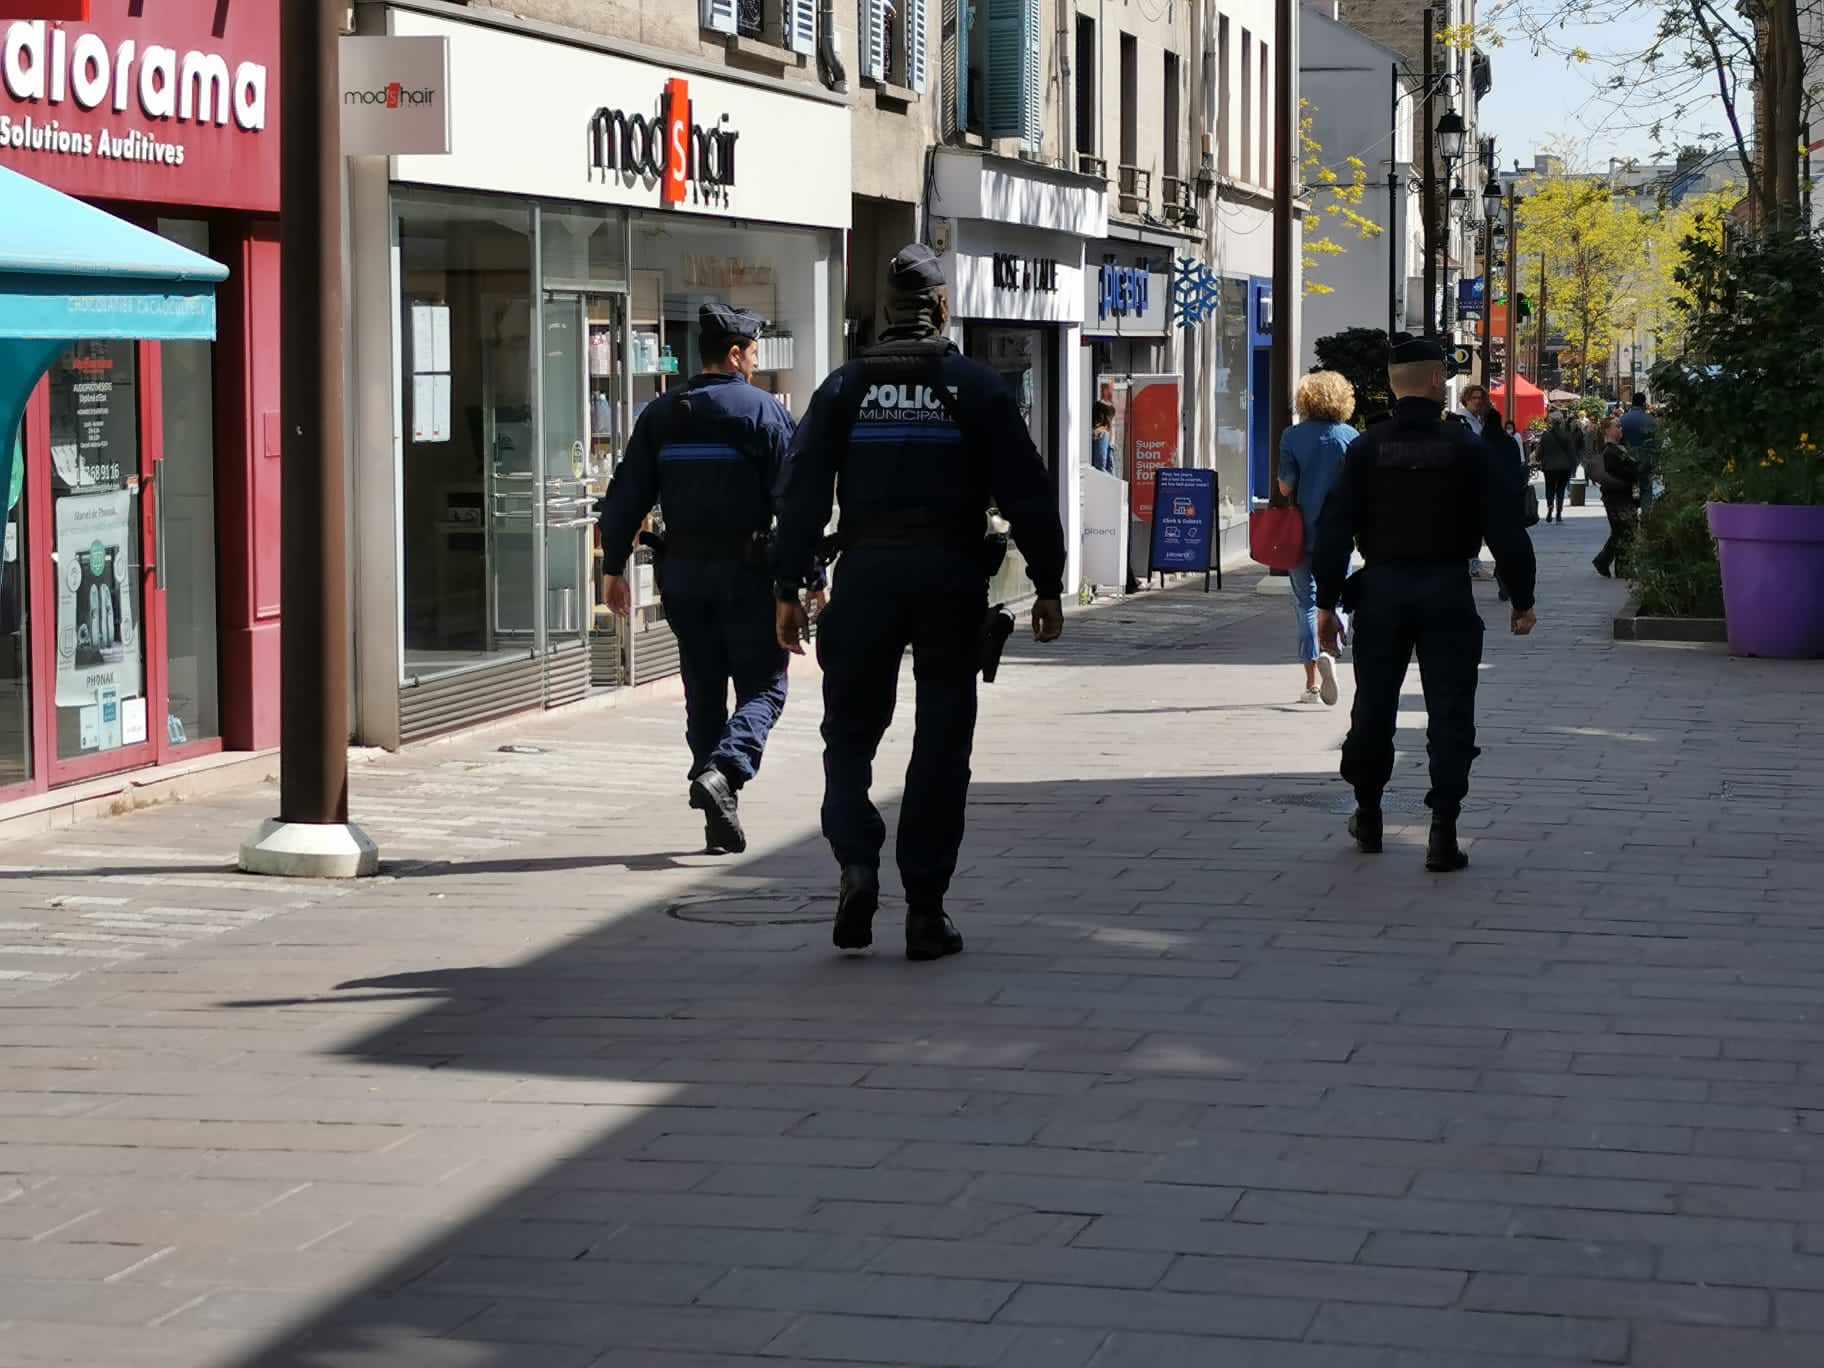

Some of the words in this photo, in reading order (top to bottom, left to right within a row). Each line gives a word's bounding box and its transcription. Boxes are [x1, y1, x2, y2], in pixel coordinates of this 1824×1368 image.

[0, 114, 92, 155] Solutions
[97, 128, 185, 166] Auditives
[861, 384, 958, 409] POLIC
[859, 409, 956, 422] MUNICIPAL
[1136, 439, 1166, 451] Super
[1136, 449, 1161, 460] bon
[1136, 460, 1166, 470] Super
